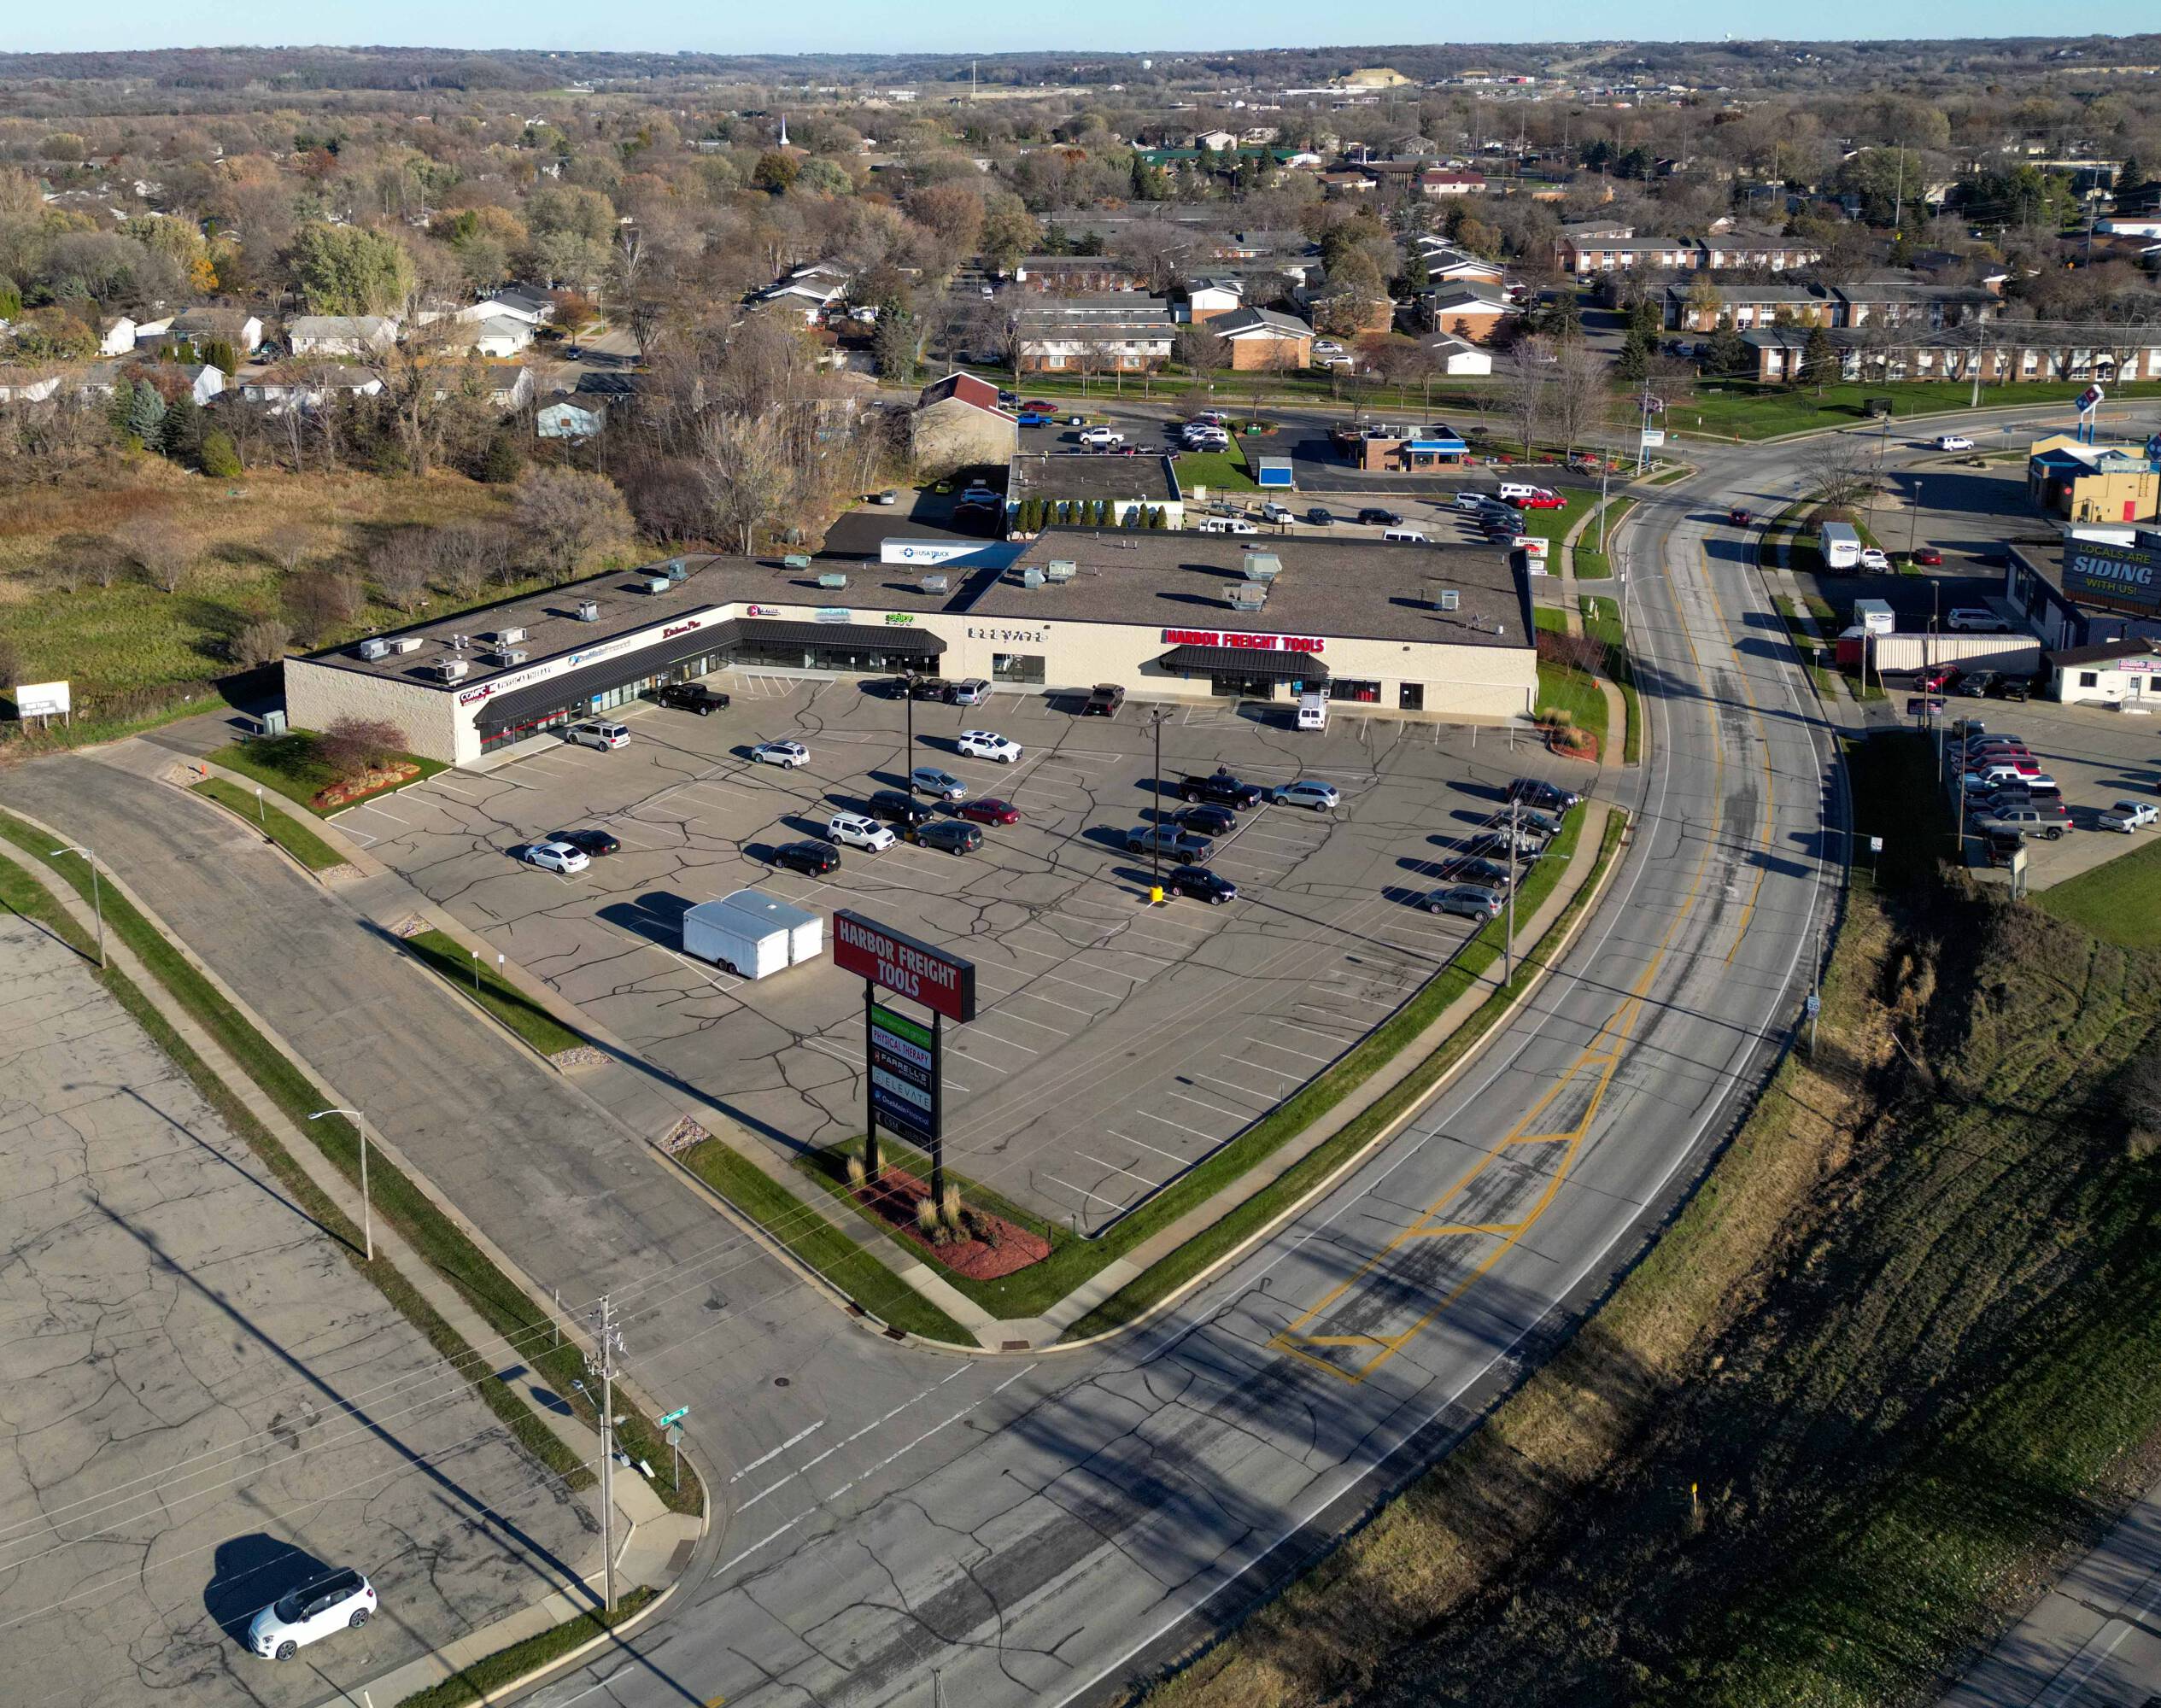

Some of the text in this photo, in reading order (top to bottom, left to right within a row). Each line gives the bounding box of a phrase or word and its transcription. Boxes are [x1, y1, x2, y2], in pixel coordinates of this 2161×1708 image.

[2079, 543, 2152, 564] LOCALS ARE
[2072, 556, 2153, 585] SIDING
[2086, 577, 2138, 595] WITH US!
[968, 628, 1049, 643] ELEVATE
[1167, 629, 1324, 653] HARBOR FREIGHT TOOLS
[840, 919, 957, 991] HARBOR FREIGHT
[877, 958, 920, 998] TOOLS
[874, 1029, 928, 1065] PHYSICAL THERAPY
[885, 1076, 929, 1108] ELEVATE
